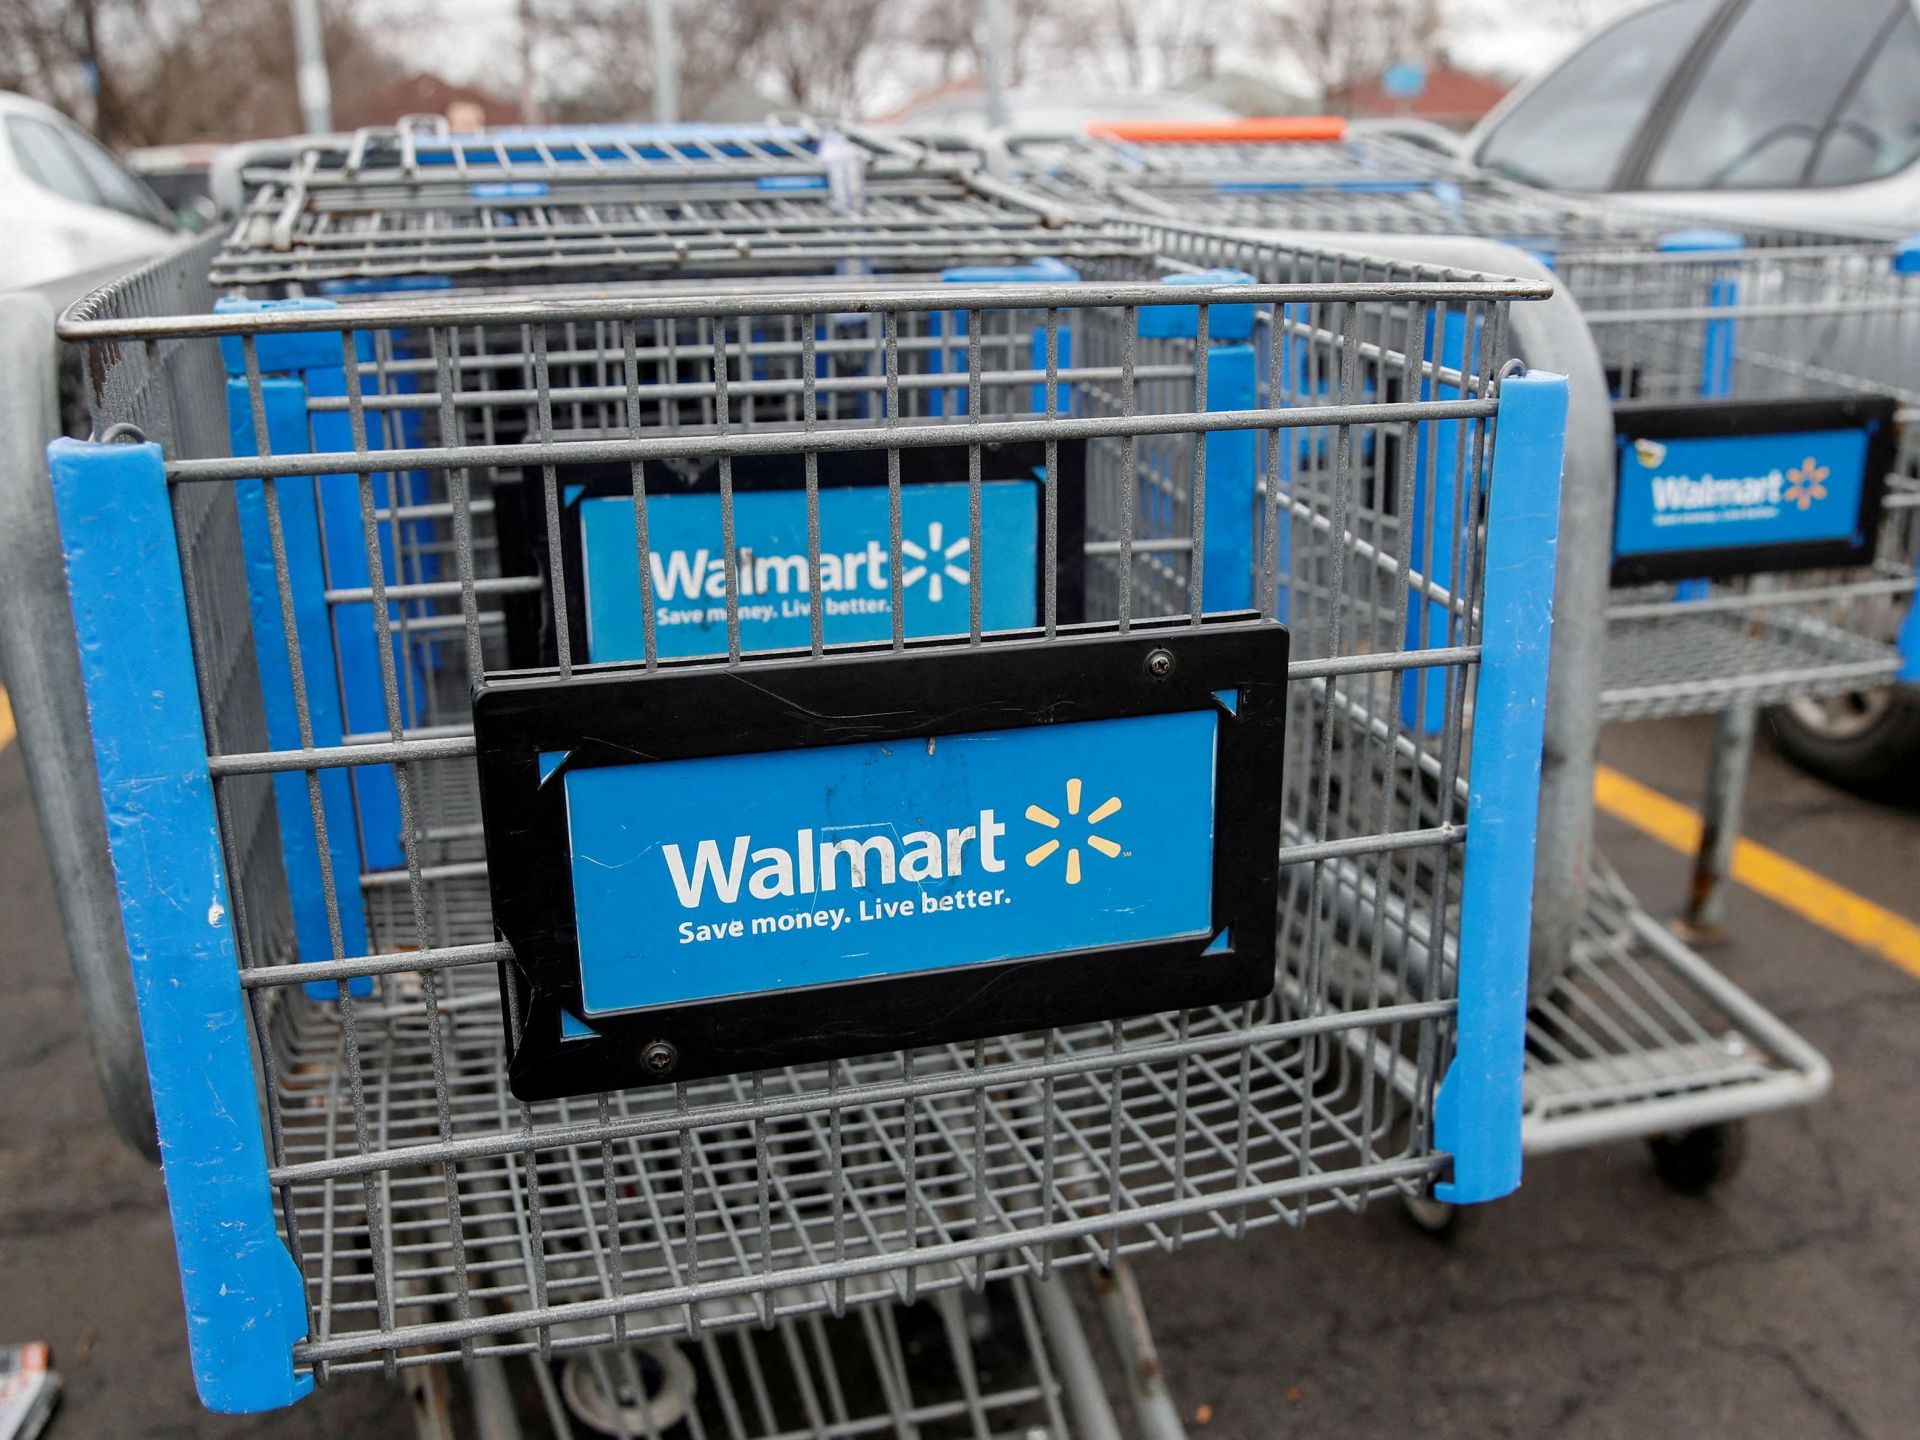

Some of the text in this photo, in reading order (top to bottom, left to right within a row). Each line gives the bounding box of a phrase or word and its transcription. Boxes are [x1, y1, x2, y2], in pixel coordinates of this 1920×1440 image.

[1652, 469, 1783, 511] Walmart
[657, 597, 892, 626] Save mney. Liv better.
[662, 809, 1006, 908] Walmart
[678, 886, 1012, 945] Save money. Live better.
